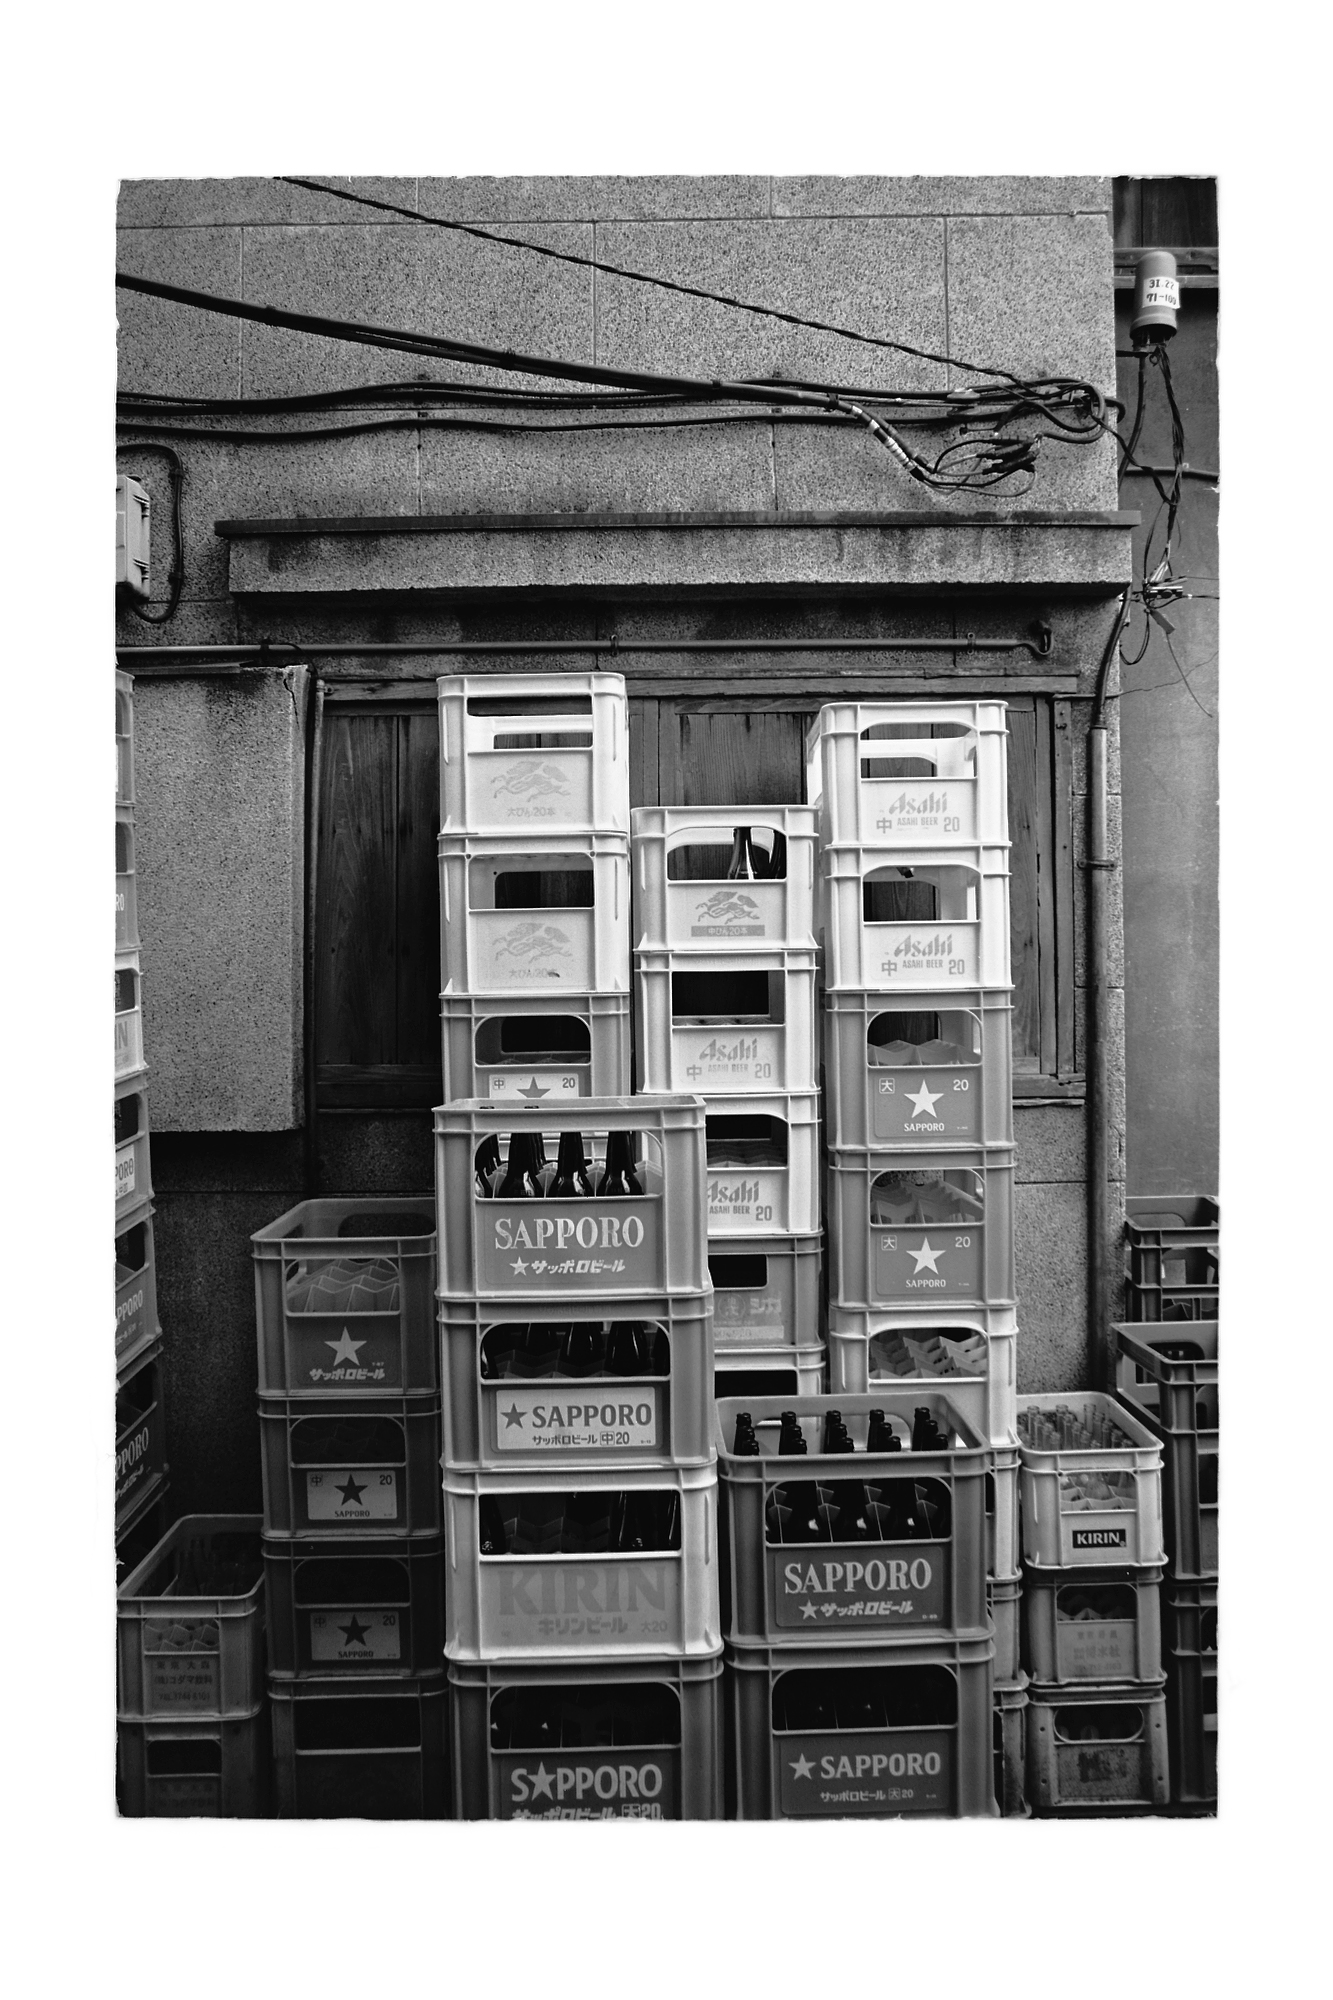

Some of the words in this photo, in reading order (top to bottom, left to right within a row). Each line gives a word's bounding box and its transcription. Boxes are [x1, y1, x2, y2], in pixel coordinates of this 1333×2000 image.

[889, 792, 948, 814] Asahi
[876, 817, 892, 834] 中
[897, 817, 918, 826] ASAHI
[921, 817, 938, 826] BEER
[944, 817, 960, 832] 20
[894, 934, 953, 957] Asahi
[881, 960, 898, 977] 中
[902, 960, 923, 969] ASAHI
[926, 960, 943, 969] BEER
[948, 959, 965, 975] 20
[699, 1038, 758, 1061] Asahi
[686, 1064, 702, 1081] 中
[708, 1064, 729, 1073] ASAHI
[731, 1063, 749, 1073] BEER
[755, 1063, 771, 1079] 20
[562, 1077, 576, 1089] 20
[880, 1079, 894, 1093] 大
[953, 1079, 969, 1091] 20
[904, 1123, 945, 1132] SAPPORO
[709, 1206, 730, 1214] ASAHI
[733, 1205, 750, 1214] BEER
[755, 1205, 773, 1222] 20
[494, 1215, 645, 1250] SAPPORO
[882, 1236, 896, 1250] 大
[955, 1236, 971, 1248] 20
[531, 1259, 626, 1275] サッポロビール
[906, 1279, 947, 1288] SAPPORO
[309, 1368, 386, 1381] サッポロビール
[532, 1403, 653, 1429] SAPPORO
[532, 1434, 598, 1446] サッポロビール
[379, 1474, 393, 1486] 20
[334, 1510, 370, 1518] SAPPORO
[1077, 1532, 1120, 1545] KIRIN
[784, 1558, 932, 1594] SAPPORO
[498, 1566, 667, 1616] KIRIN
[820, 1600, 913, 1617] サッポロビール
[382, 1615, 396, 1626] 20
[538, 1616, 629, 1636] キリンビール
[338, 1650, 374, 1659] SAPPORO
[820, 1752, 942, 1779] SAPPORO
[820, 1790, 886, 1802] サッポロビール
